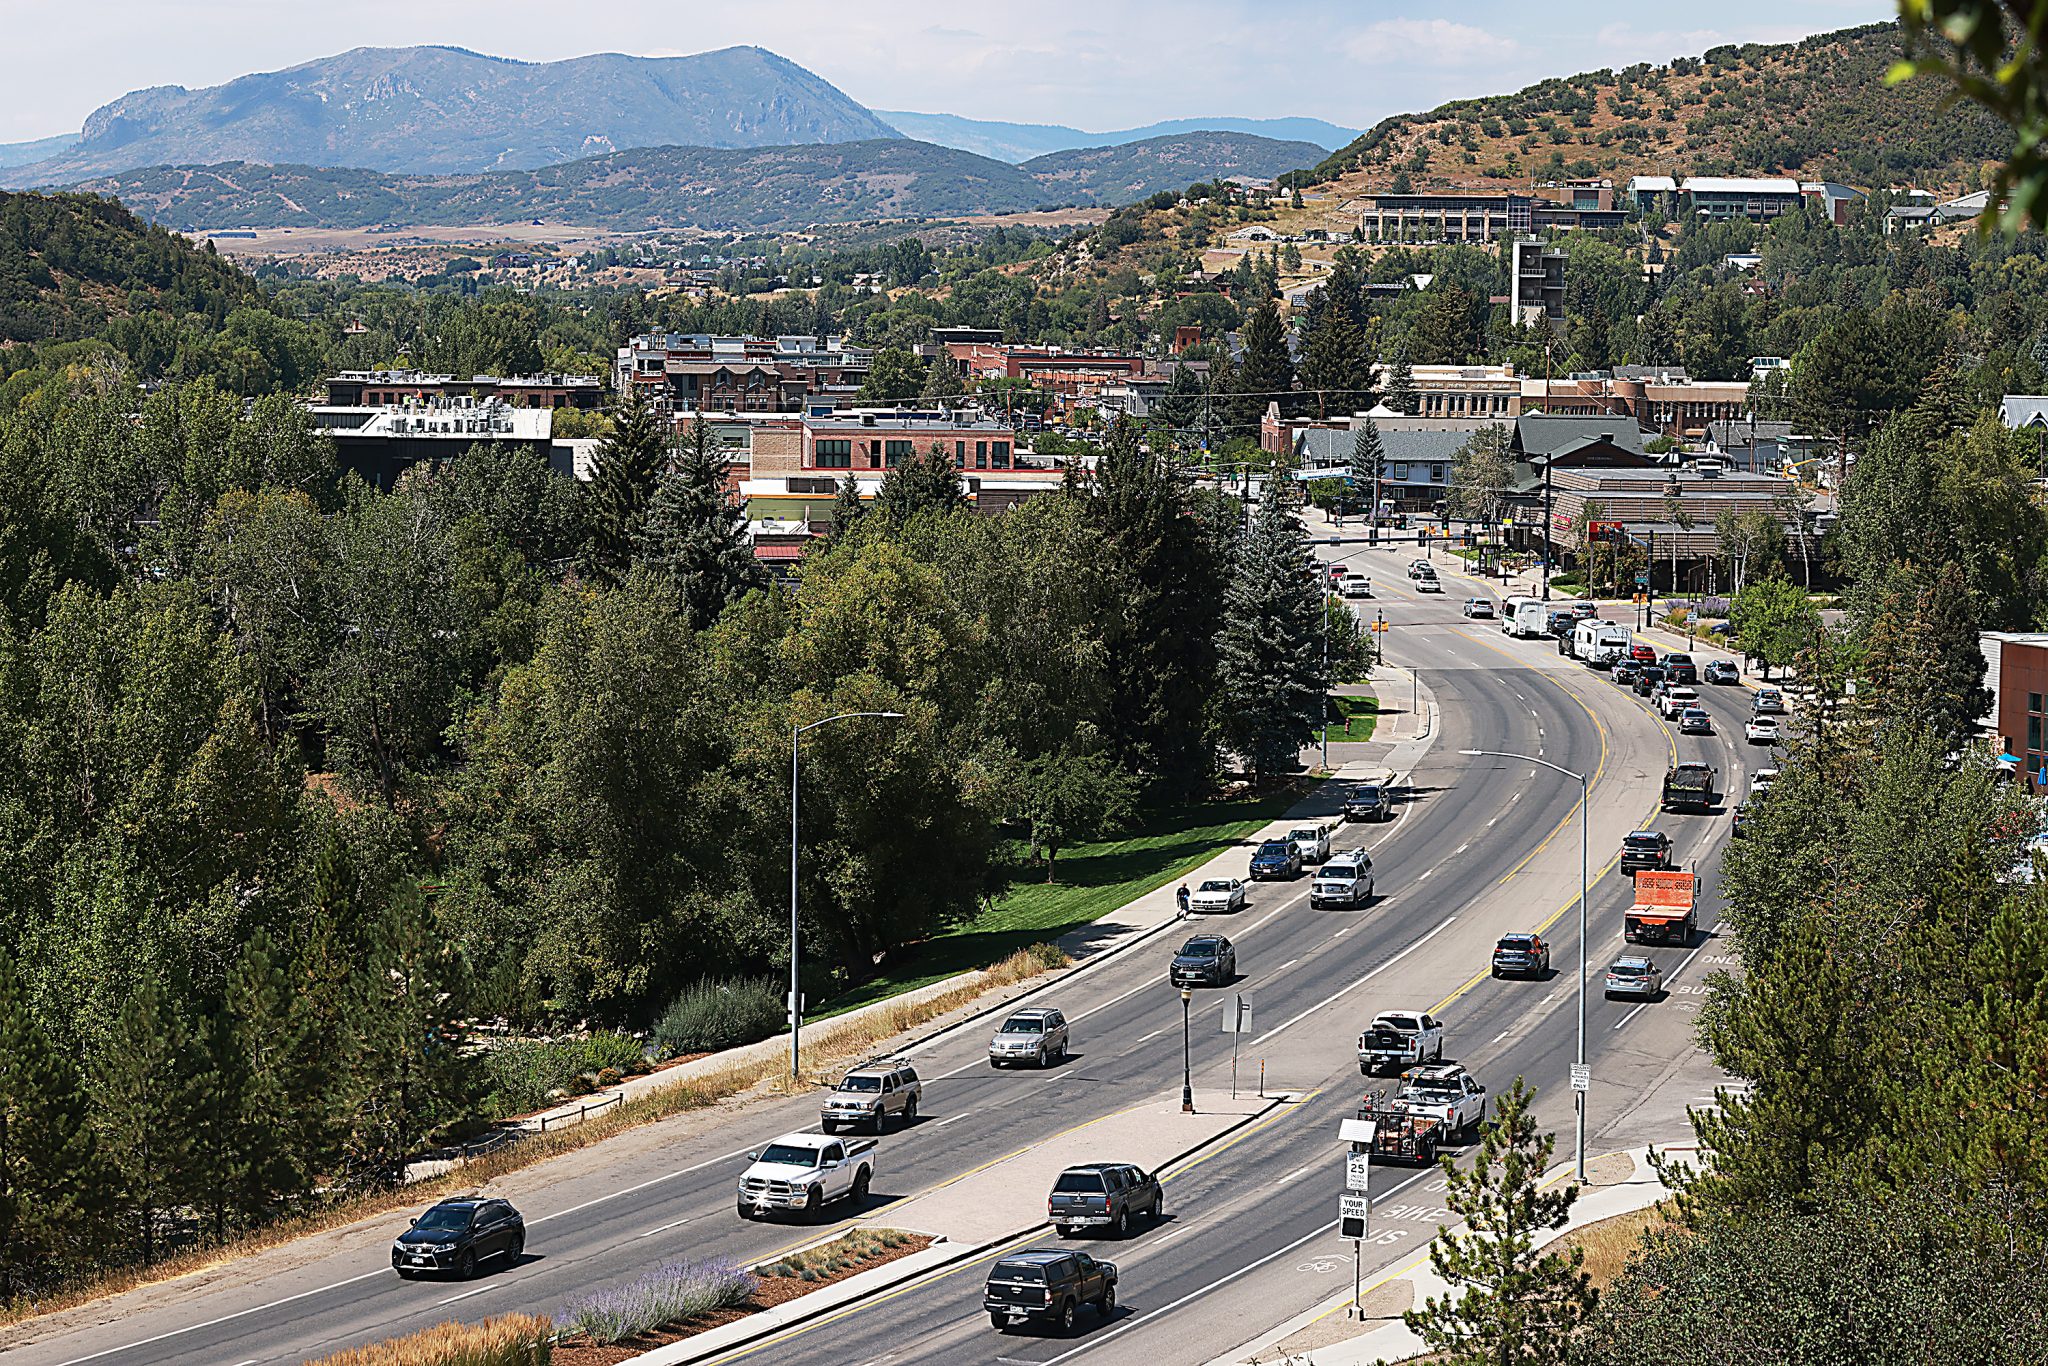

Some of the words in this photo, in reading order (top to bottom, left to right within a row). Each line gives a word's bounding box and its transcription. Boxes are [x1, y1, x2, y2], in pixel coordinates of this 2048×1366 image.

[1701, 955, 1741, 965] ONL
[1350, 1163, 1365, 1174] 25
[1344, 1199, 1363, 1208] YOUR
[1342, 1207, 1365, 1217] SPEED
[1381, 1204, 1453, 1222] BIKE
